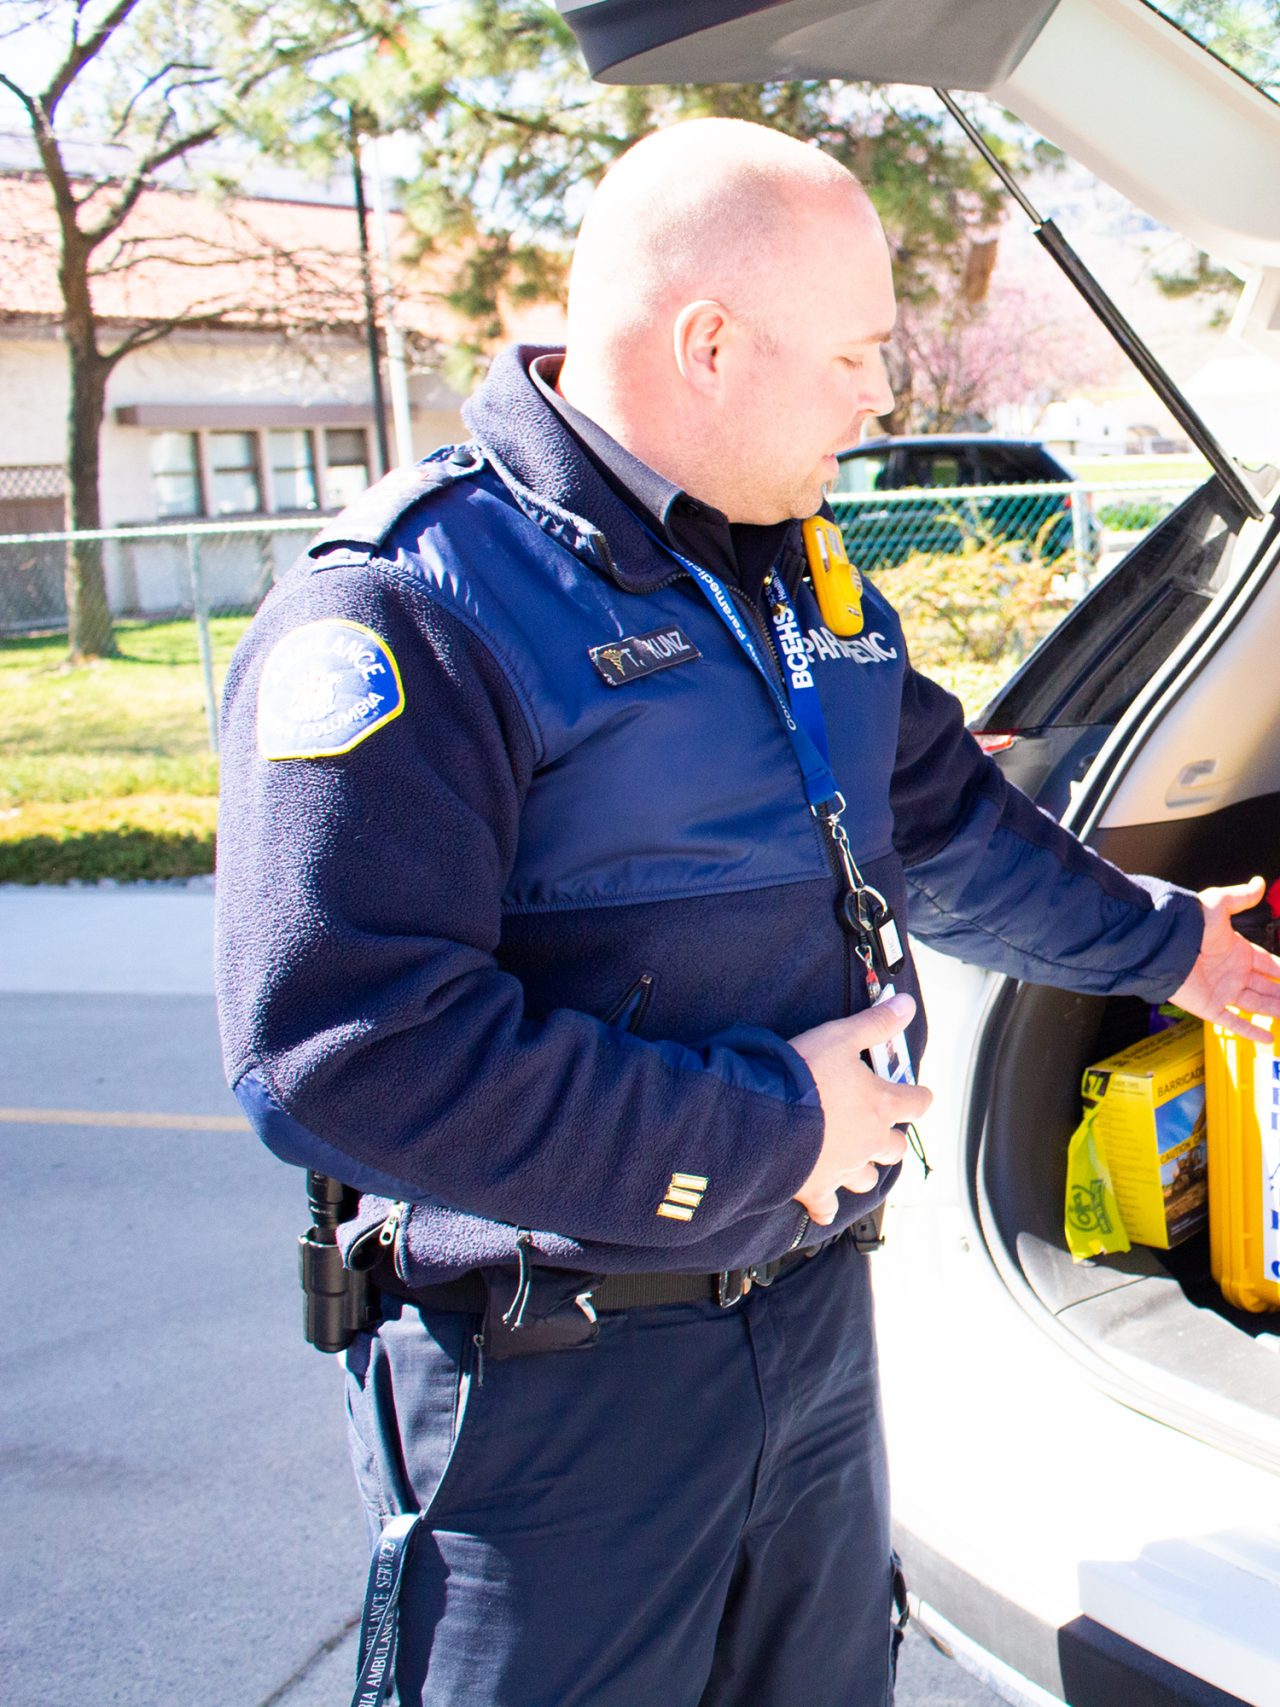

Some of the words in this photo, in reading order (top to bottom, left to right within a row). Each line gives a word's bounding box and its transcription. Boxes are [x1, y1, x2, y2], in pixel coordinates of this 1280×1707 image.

[642, 631, 691, 660] KUNZ
[773, 607, 815, 689] BCEHS
[375, 1539, 397, 1588] SERVICE
[364, 1593, 390, 1660] BULANCE
[365, 1609, 395, 1688] AMBULANCE
